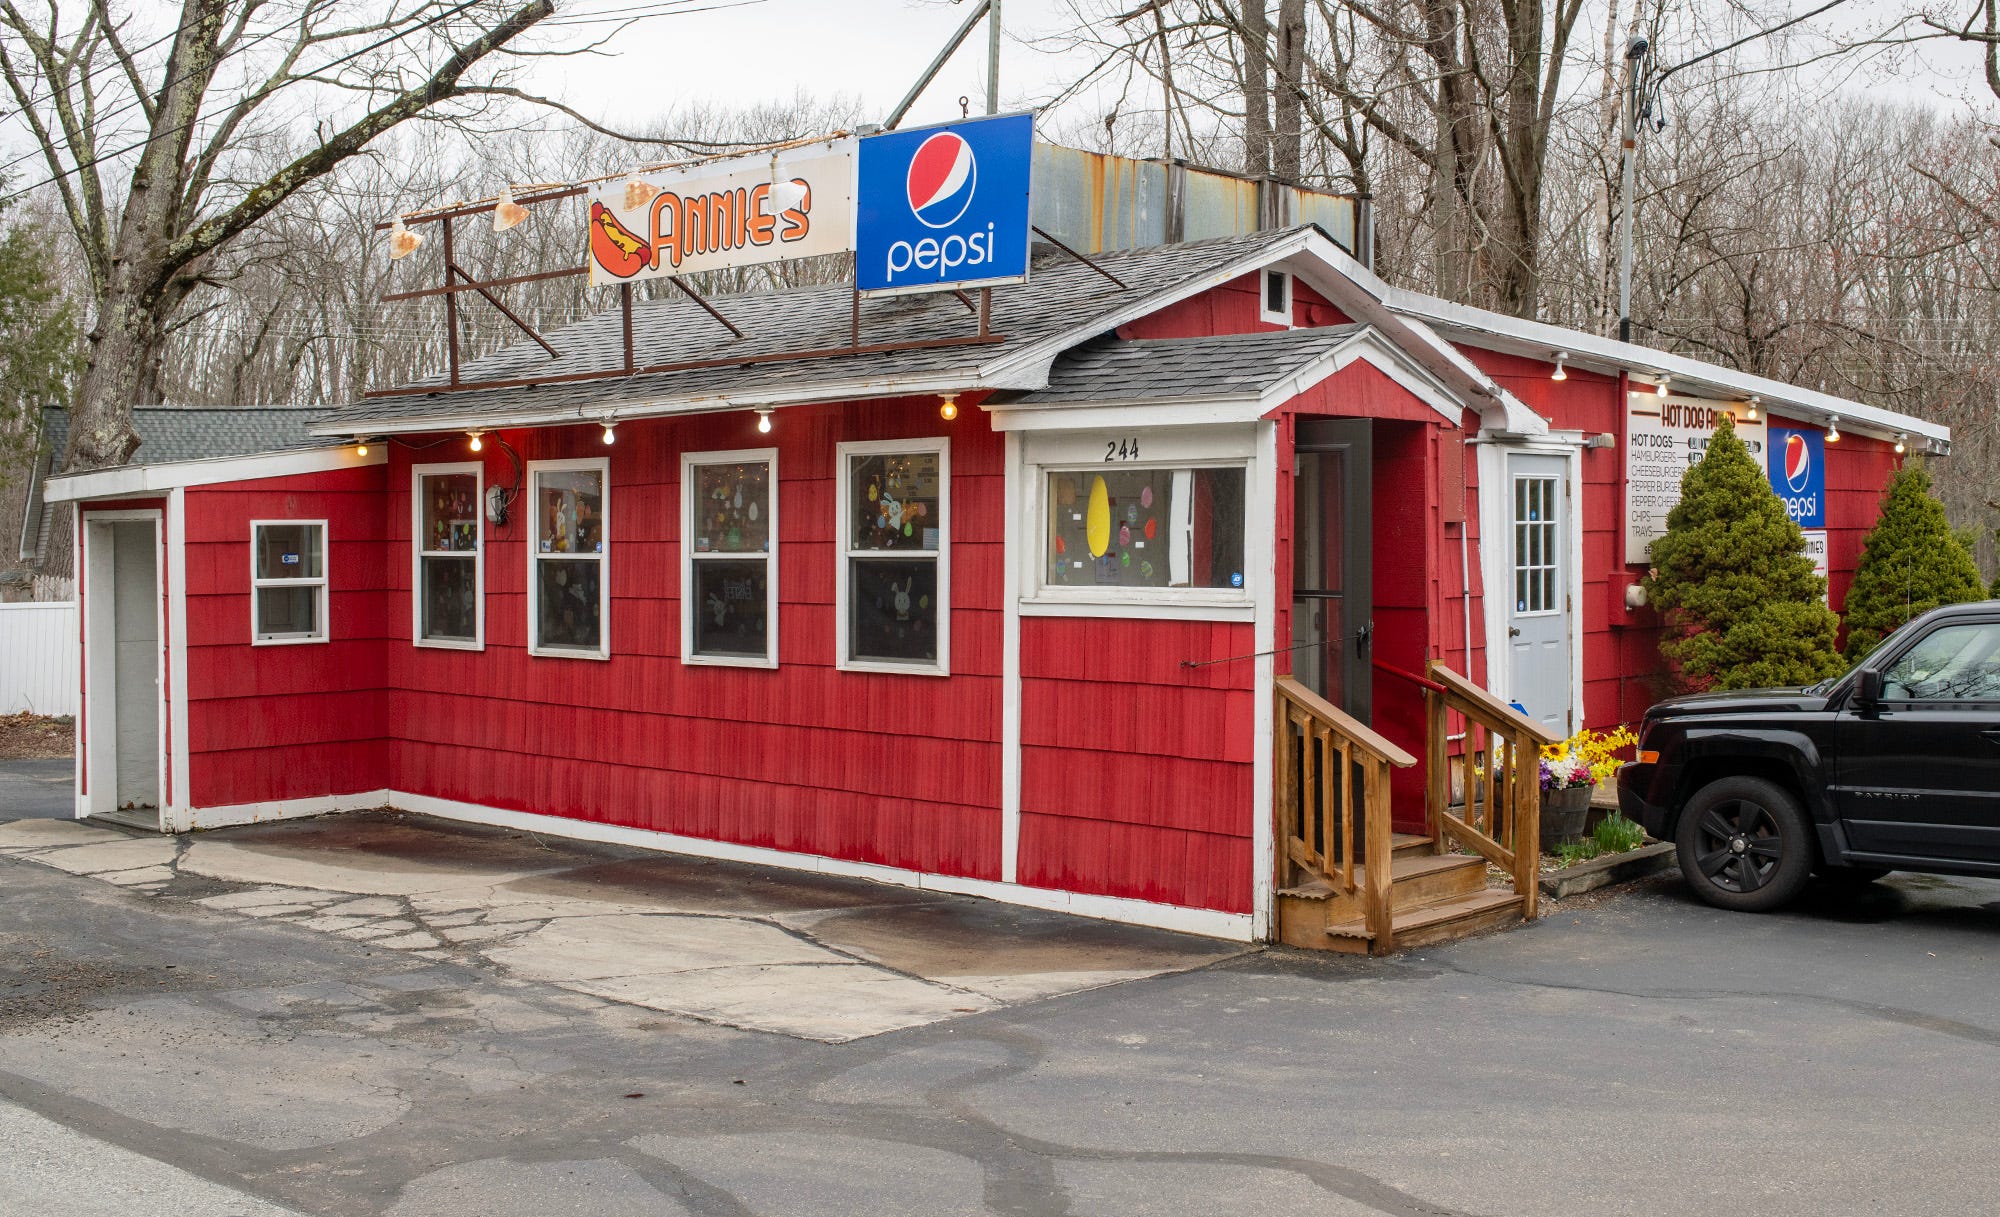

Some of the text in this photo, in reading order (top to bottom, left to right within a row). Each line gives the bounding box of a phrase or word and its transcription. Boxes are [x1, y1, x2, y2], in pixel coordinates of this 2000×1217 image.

[886, 221, 995, 283] pepsi
[1662, 404, 1682, 427] HOT
[1684, 405, 1704, 429] DOG
[1631, 433, 1648, 446] HOT
[1650, 435, 1673, 448] DOGS
[1104, 438, 1139, 462] 244
[1631, 450, 1676, 463] HAMBURGERS
[1631, 480, 1656, 492] PEPPER
[1631, 495, 1656, 507] PEPPER
[1631, 510, 1651, 522] CHIPS
[1631, 526, 1653, 537] TRAYS
